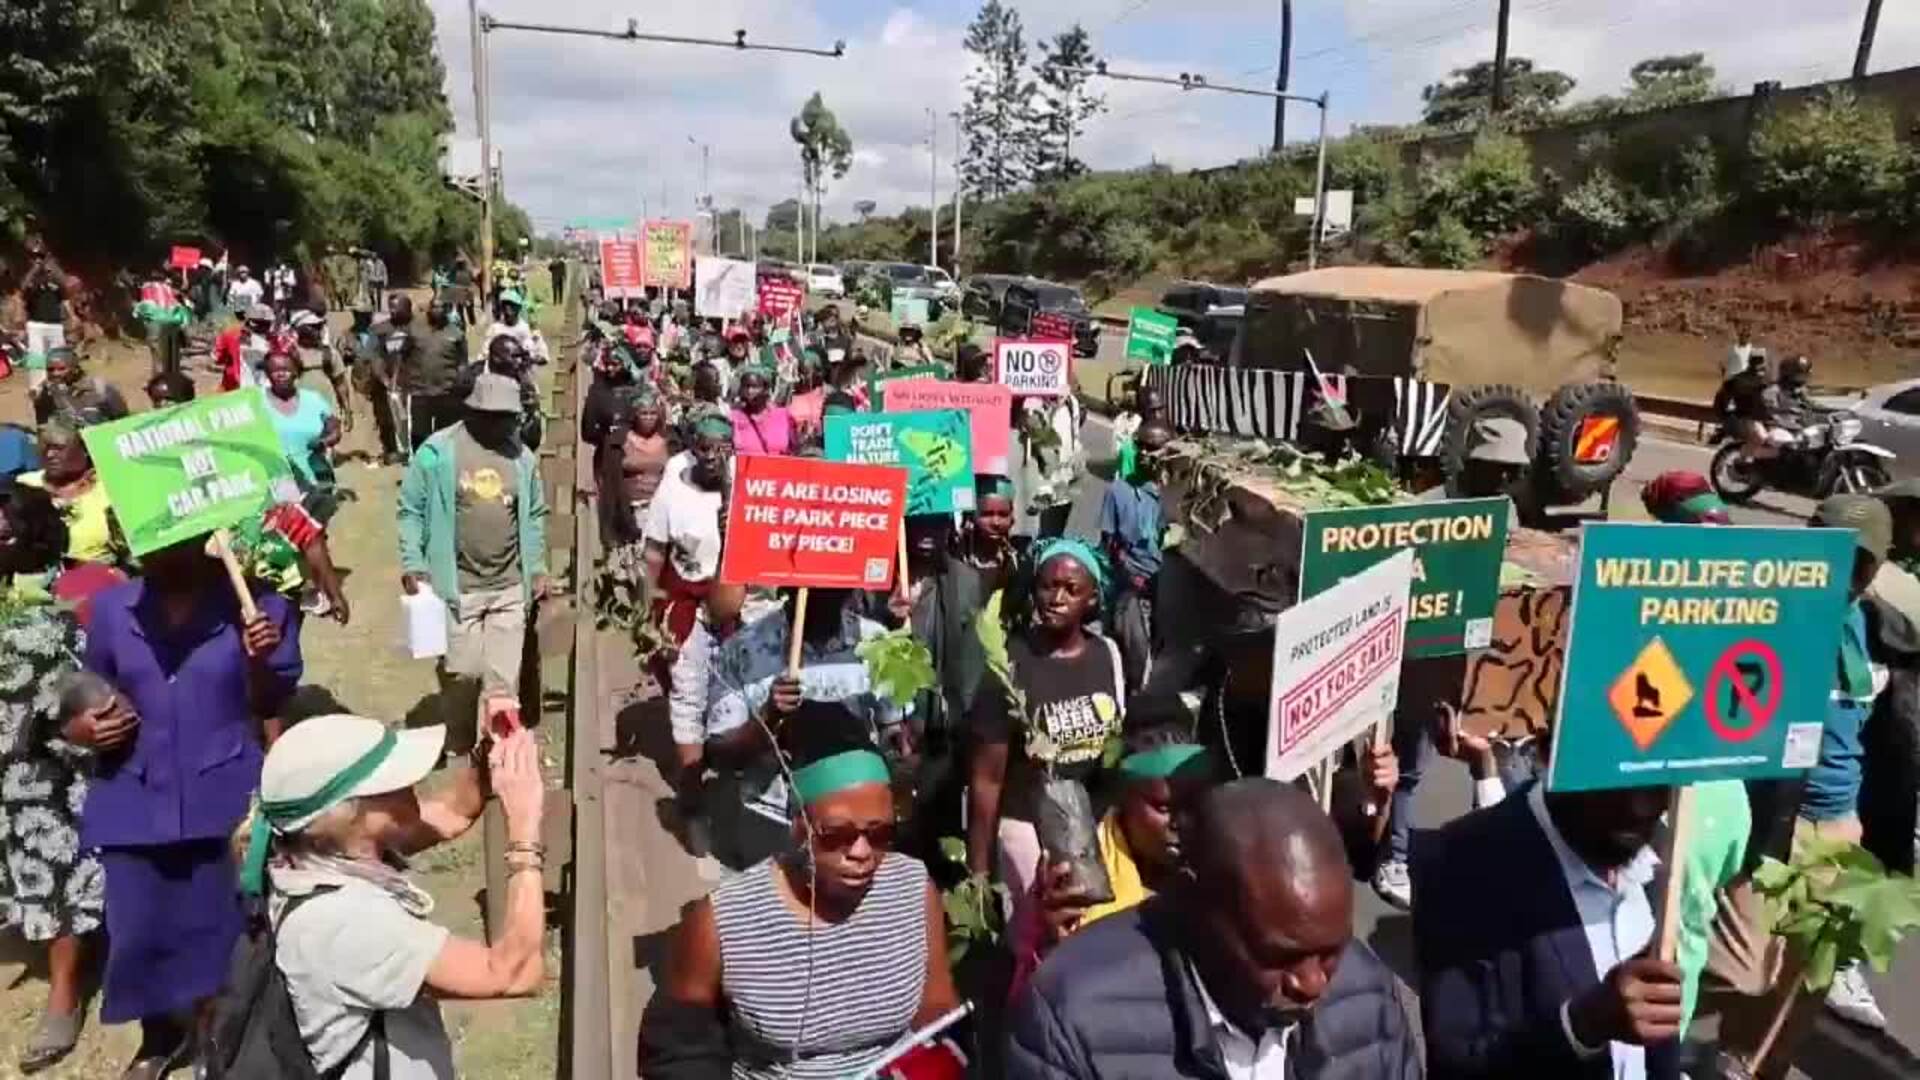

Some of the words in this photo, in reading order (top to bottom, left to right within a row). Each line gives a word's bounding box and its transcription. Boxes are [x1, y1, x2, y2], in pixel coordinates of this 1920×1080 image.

[1006, 350, 1035, 373] NO
[1004, 374, 1058, 388] PARKING
[116, 418, 205, 459] NATIONAL
[208, 403, 254, 430] PARK
[851, 436, 894, 450] TRADE
[181, 446, 216, 479] NOT
[745, 479, 777, 498] WE
[781, 482, 819, 500] ARE
[823, 485, 892, 506] LOSING
[743, 505, 779, 524] THE
[783, 509, 835, 528] PARK
[839, 512, 889, 531] PIECE
[768, 533, 795, 550] BY
[798, 536, 854, 554] PIECE!
[1321, 514, 1493, 553] PROTECTION
[1595, 557, 1748, 588] WILDLIFE
[1751, 559, 1830, 589] OVER
[1640, 596, 1780, 625] PARKING
[1290, 614, 1351, 662] PROTECTED
[1353, 601, 1381, 628] LAND
[1381, 594, 1392, 615] IS
[1289, 688, 1323, 727] NOT
[1325, 661, 1356, 699] FOR
[1357, 630, 1393, 677] SALE
[1046, 705, 1095, 733] BEER
